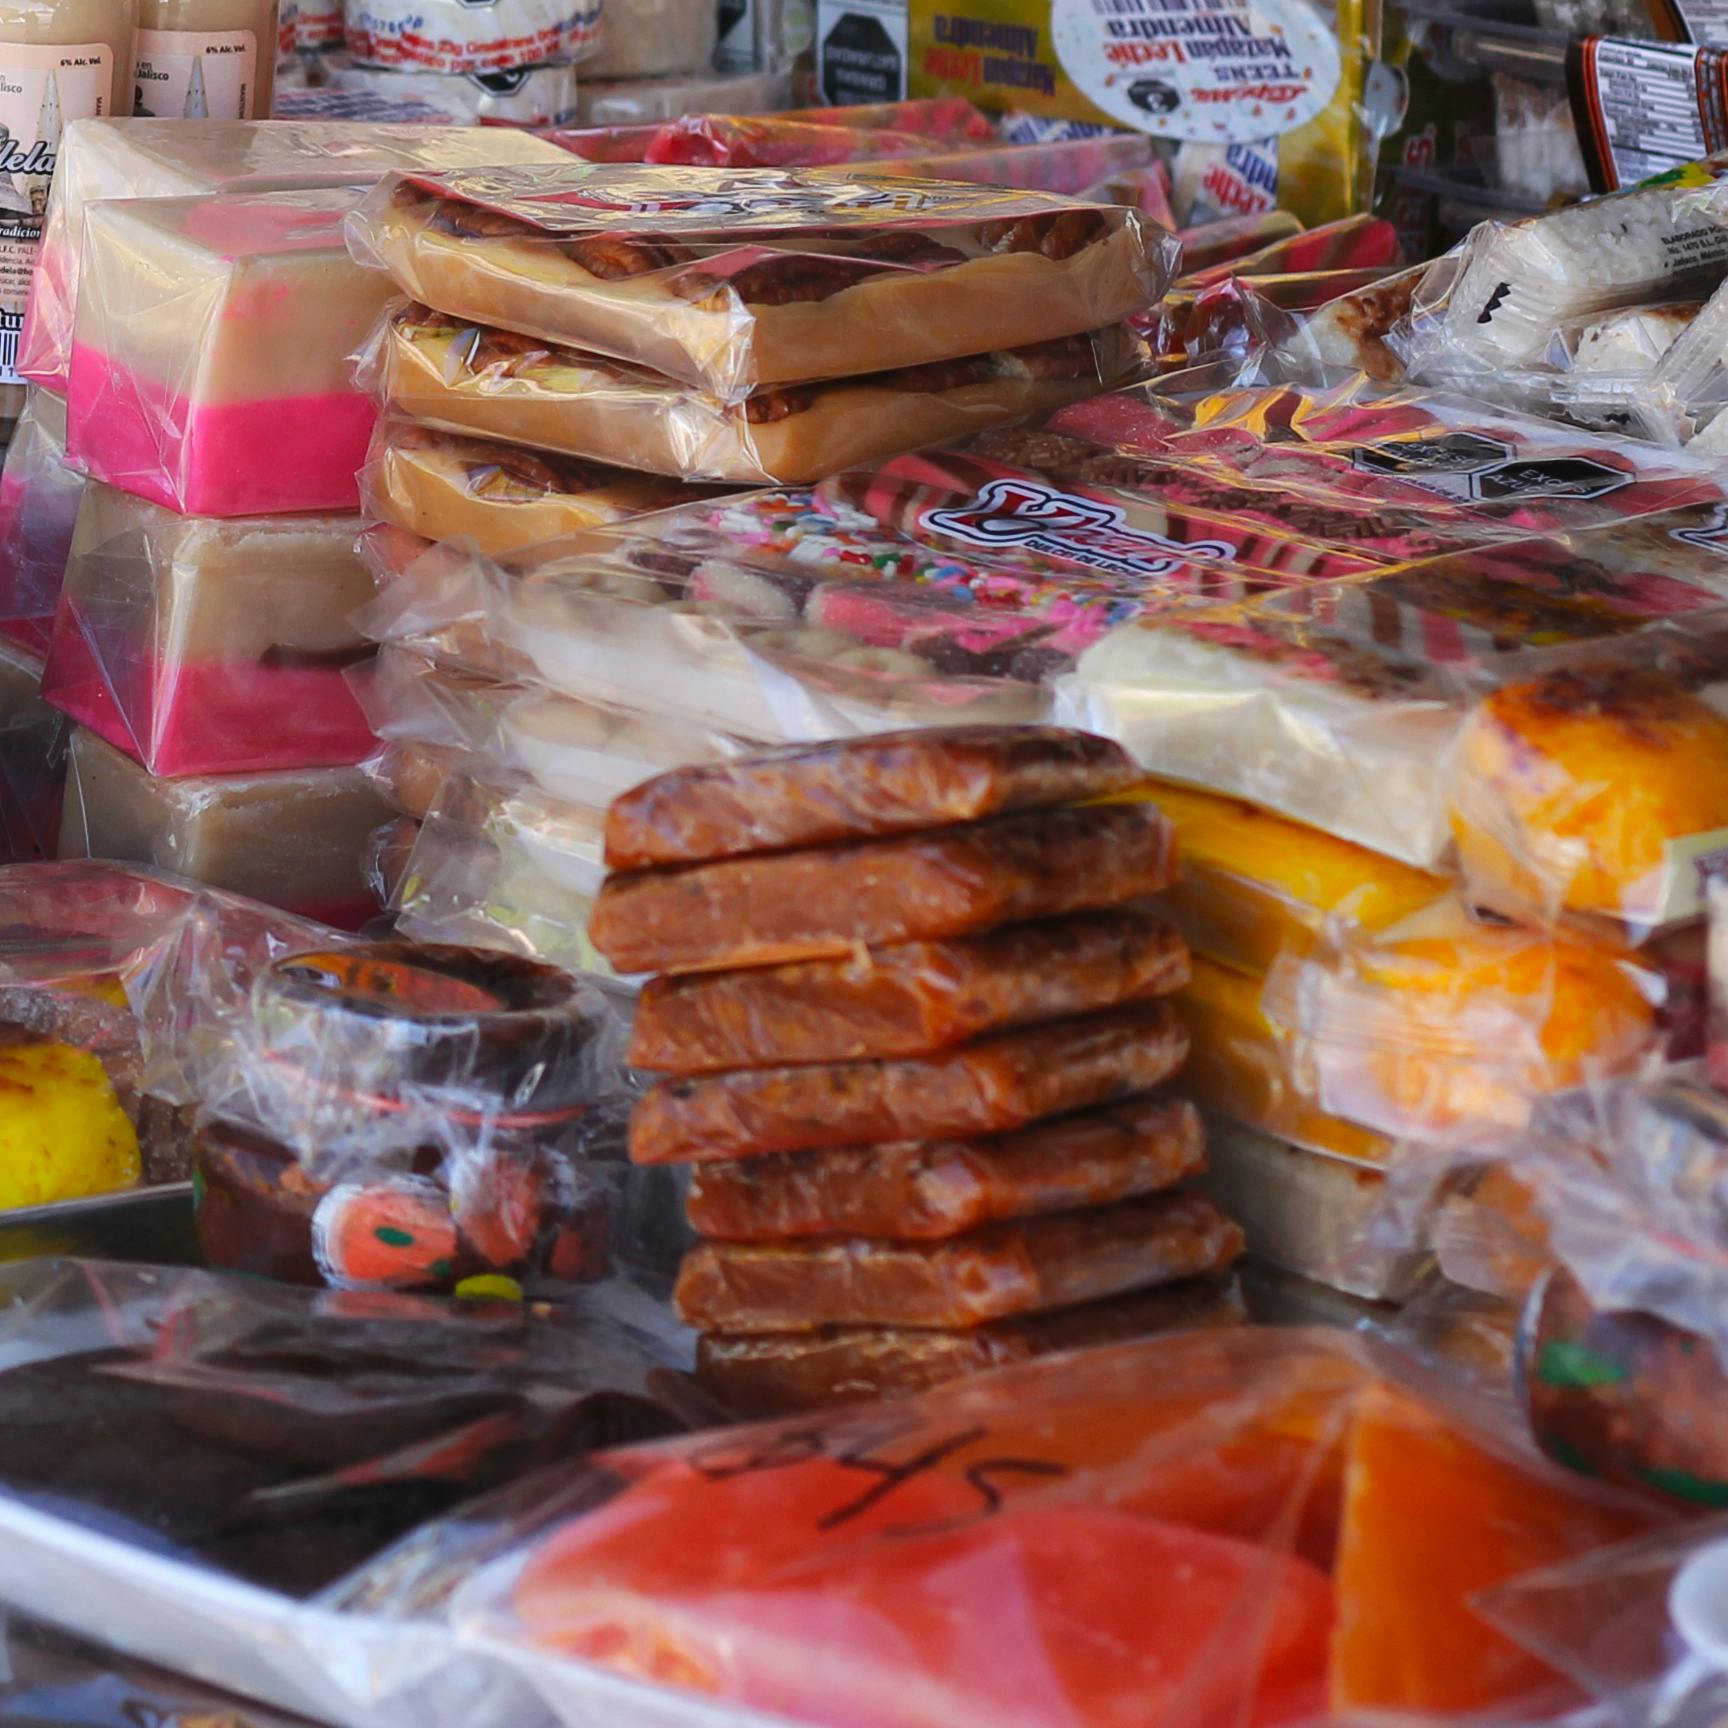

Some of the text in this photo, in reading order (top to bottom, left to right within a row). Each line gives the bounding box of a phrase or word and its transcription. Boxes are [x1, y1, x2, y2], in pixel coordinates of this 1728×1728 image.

[1105, 14, 1255, 41] Almendra
[1104, 38, 1187, 66] Leche
[1213, 62, 1302, 82] TEENS
